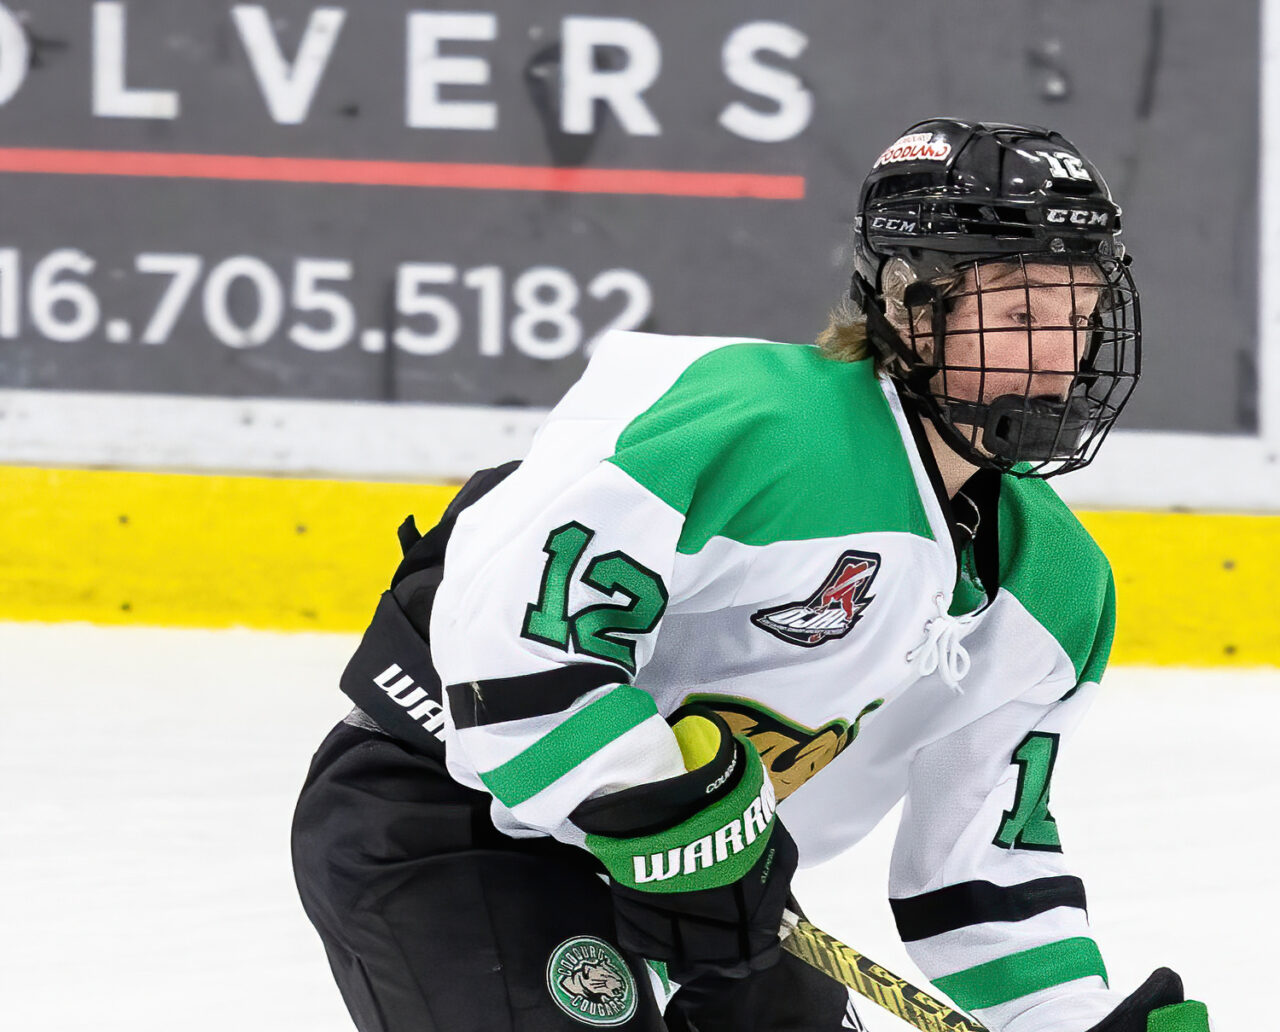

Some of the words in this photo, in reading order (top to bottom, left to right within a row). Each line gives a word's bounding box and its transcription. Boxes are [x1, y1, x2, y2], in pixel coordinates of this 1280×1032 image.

[1035, 151, 1092, 181] 12
[872, 217, 916, 232] CCM
[1047, 208, 1108, 226] CCM
[520, 520, 669, 677] 12
[573, 995, 625, 1016] COUGARS
